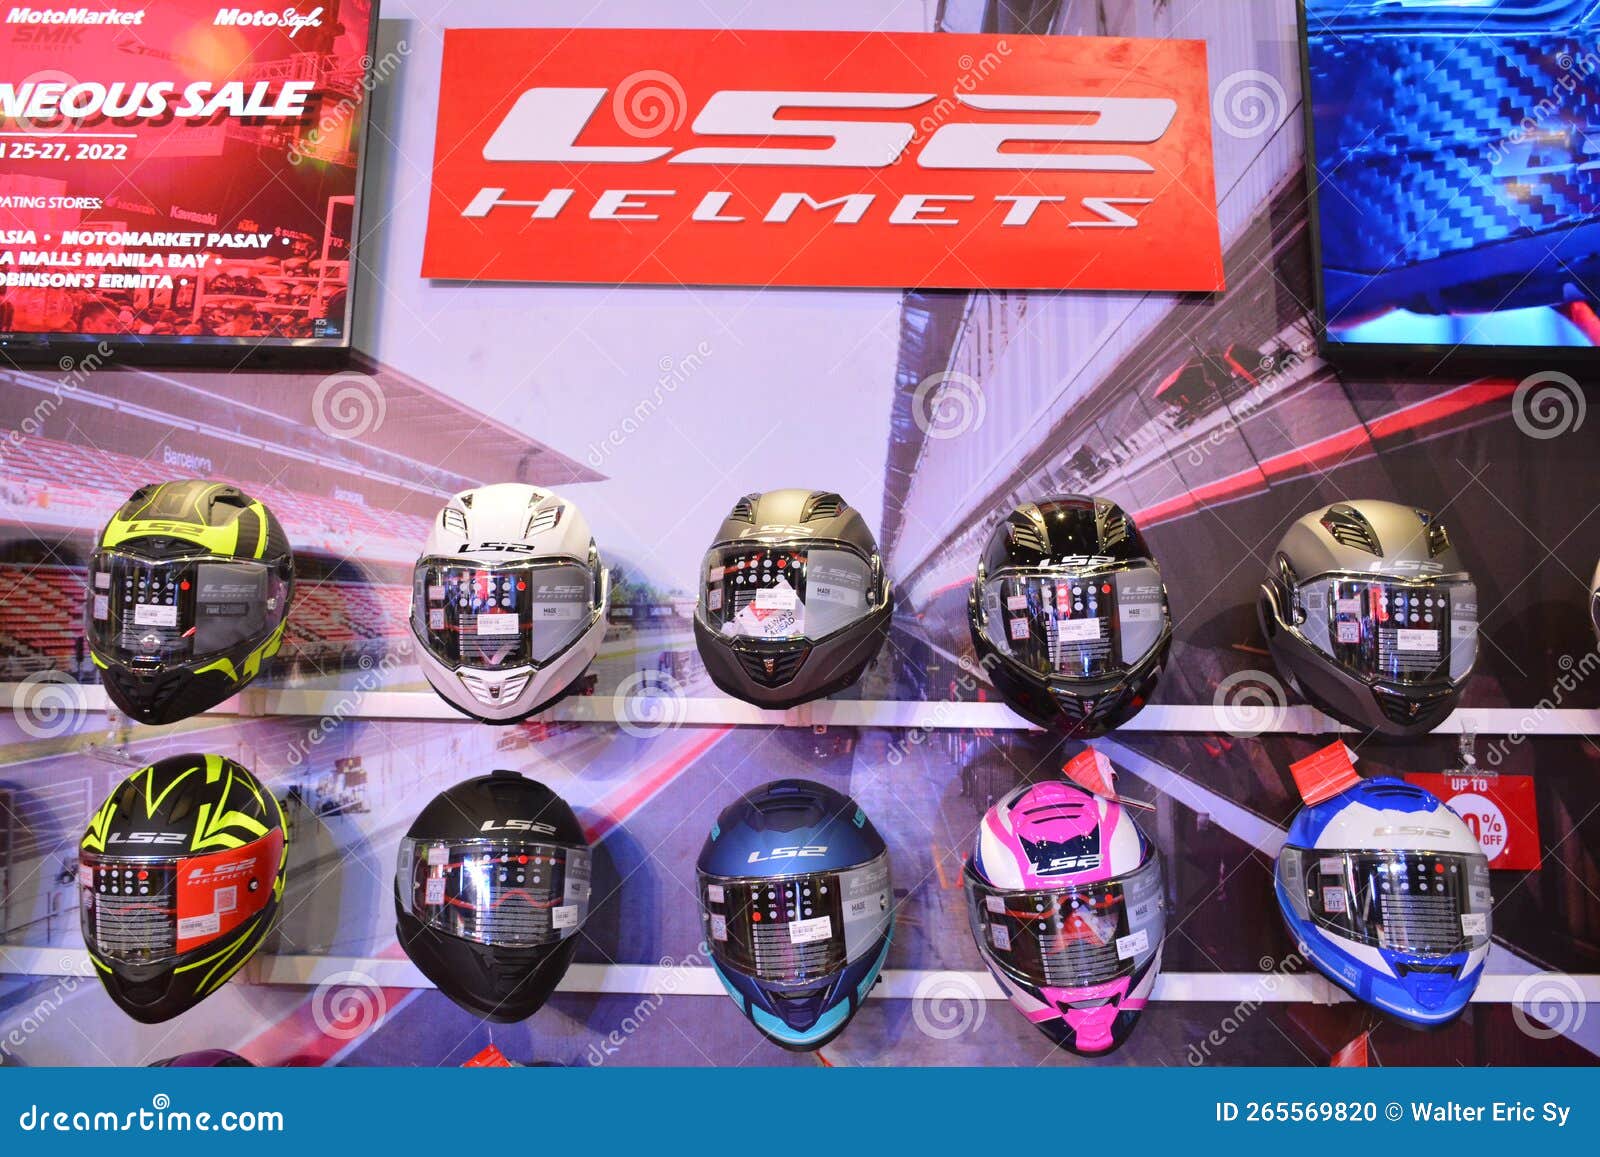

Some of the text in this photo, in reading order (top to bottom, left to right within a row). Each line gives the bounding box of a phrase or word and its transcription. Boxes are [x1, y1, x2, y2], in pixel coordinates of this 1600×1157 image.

[6, 8, 145, 25] MotoMarket
[12, 26, 87, 44] SMK
[174, 81, 315, 117] SALE
[482, 87, 1178, 173] LS2
[9, 143, 71, 161] 25-27,
[76, 144, 128, 160] 2022
[170, 205, 218, 226] Kawasaki
[461, 188, 1155, 228] HELMETS
[61, 231, 204, 247] MOTOMARKET
[206, 233, 272, 248] PASAY
[18, 251, 82, 266] MALLS
[85, 252, 164, 267] MANILA
[168, 253, 209, 268] BAY
[98, 274, 173, 288] ERMITA
[126, 522, 205, 536] LS2
[739, 524, 815, 538] LS2
[458, 542, 535, 554] LS2
[1039, 555, 1116, 568] LS2
[1369, 560, 1444, 573] LS2
[1451, 778, 1488, 792] UP TO
[480, 819, 556, 835] LS2
[1372, 825, 1451, 838] LS2
[107, 831, 188, 845] LS2
[1483, 834, 1503, 846] OFF
[747, 846, 828, 864] LS2
[188, 857, 256, 879] LS2
[1027, 853, 1104, 875] LS2
